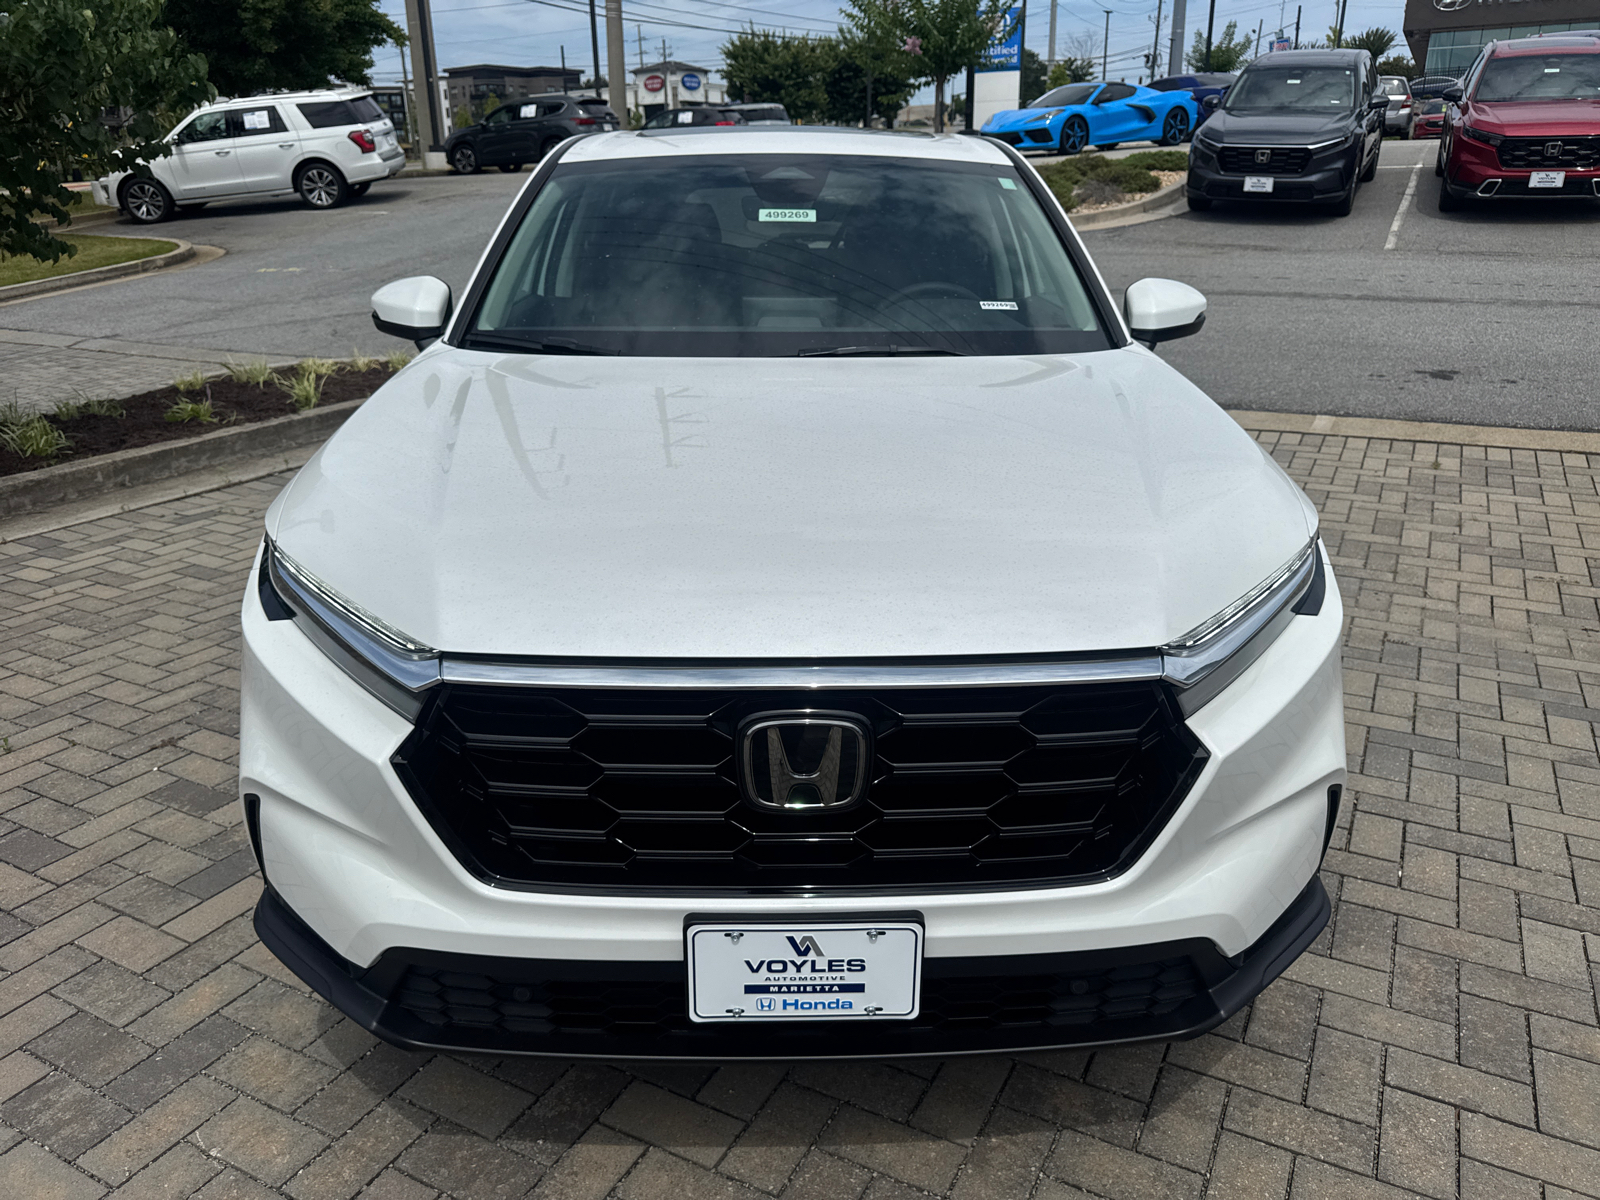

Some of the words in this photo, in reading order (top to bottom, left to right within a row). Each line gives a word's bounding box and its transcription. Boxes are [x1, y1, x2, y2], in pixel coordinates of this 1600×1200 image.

[765, 211, 809, 219] 499269
[744, 958, 867, 973] VOYLES
[782, 998, 853, 1010] Honda
